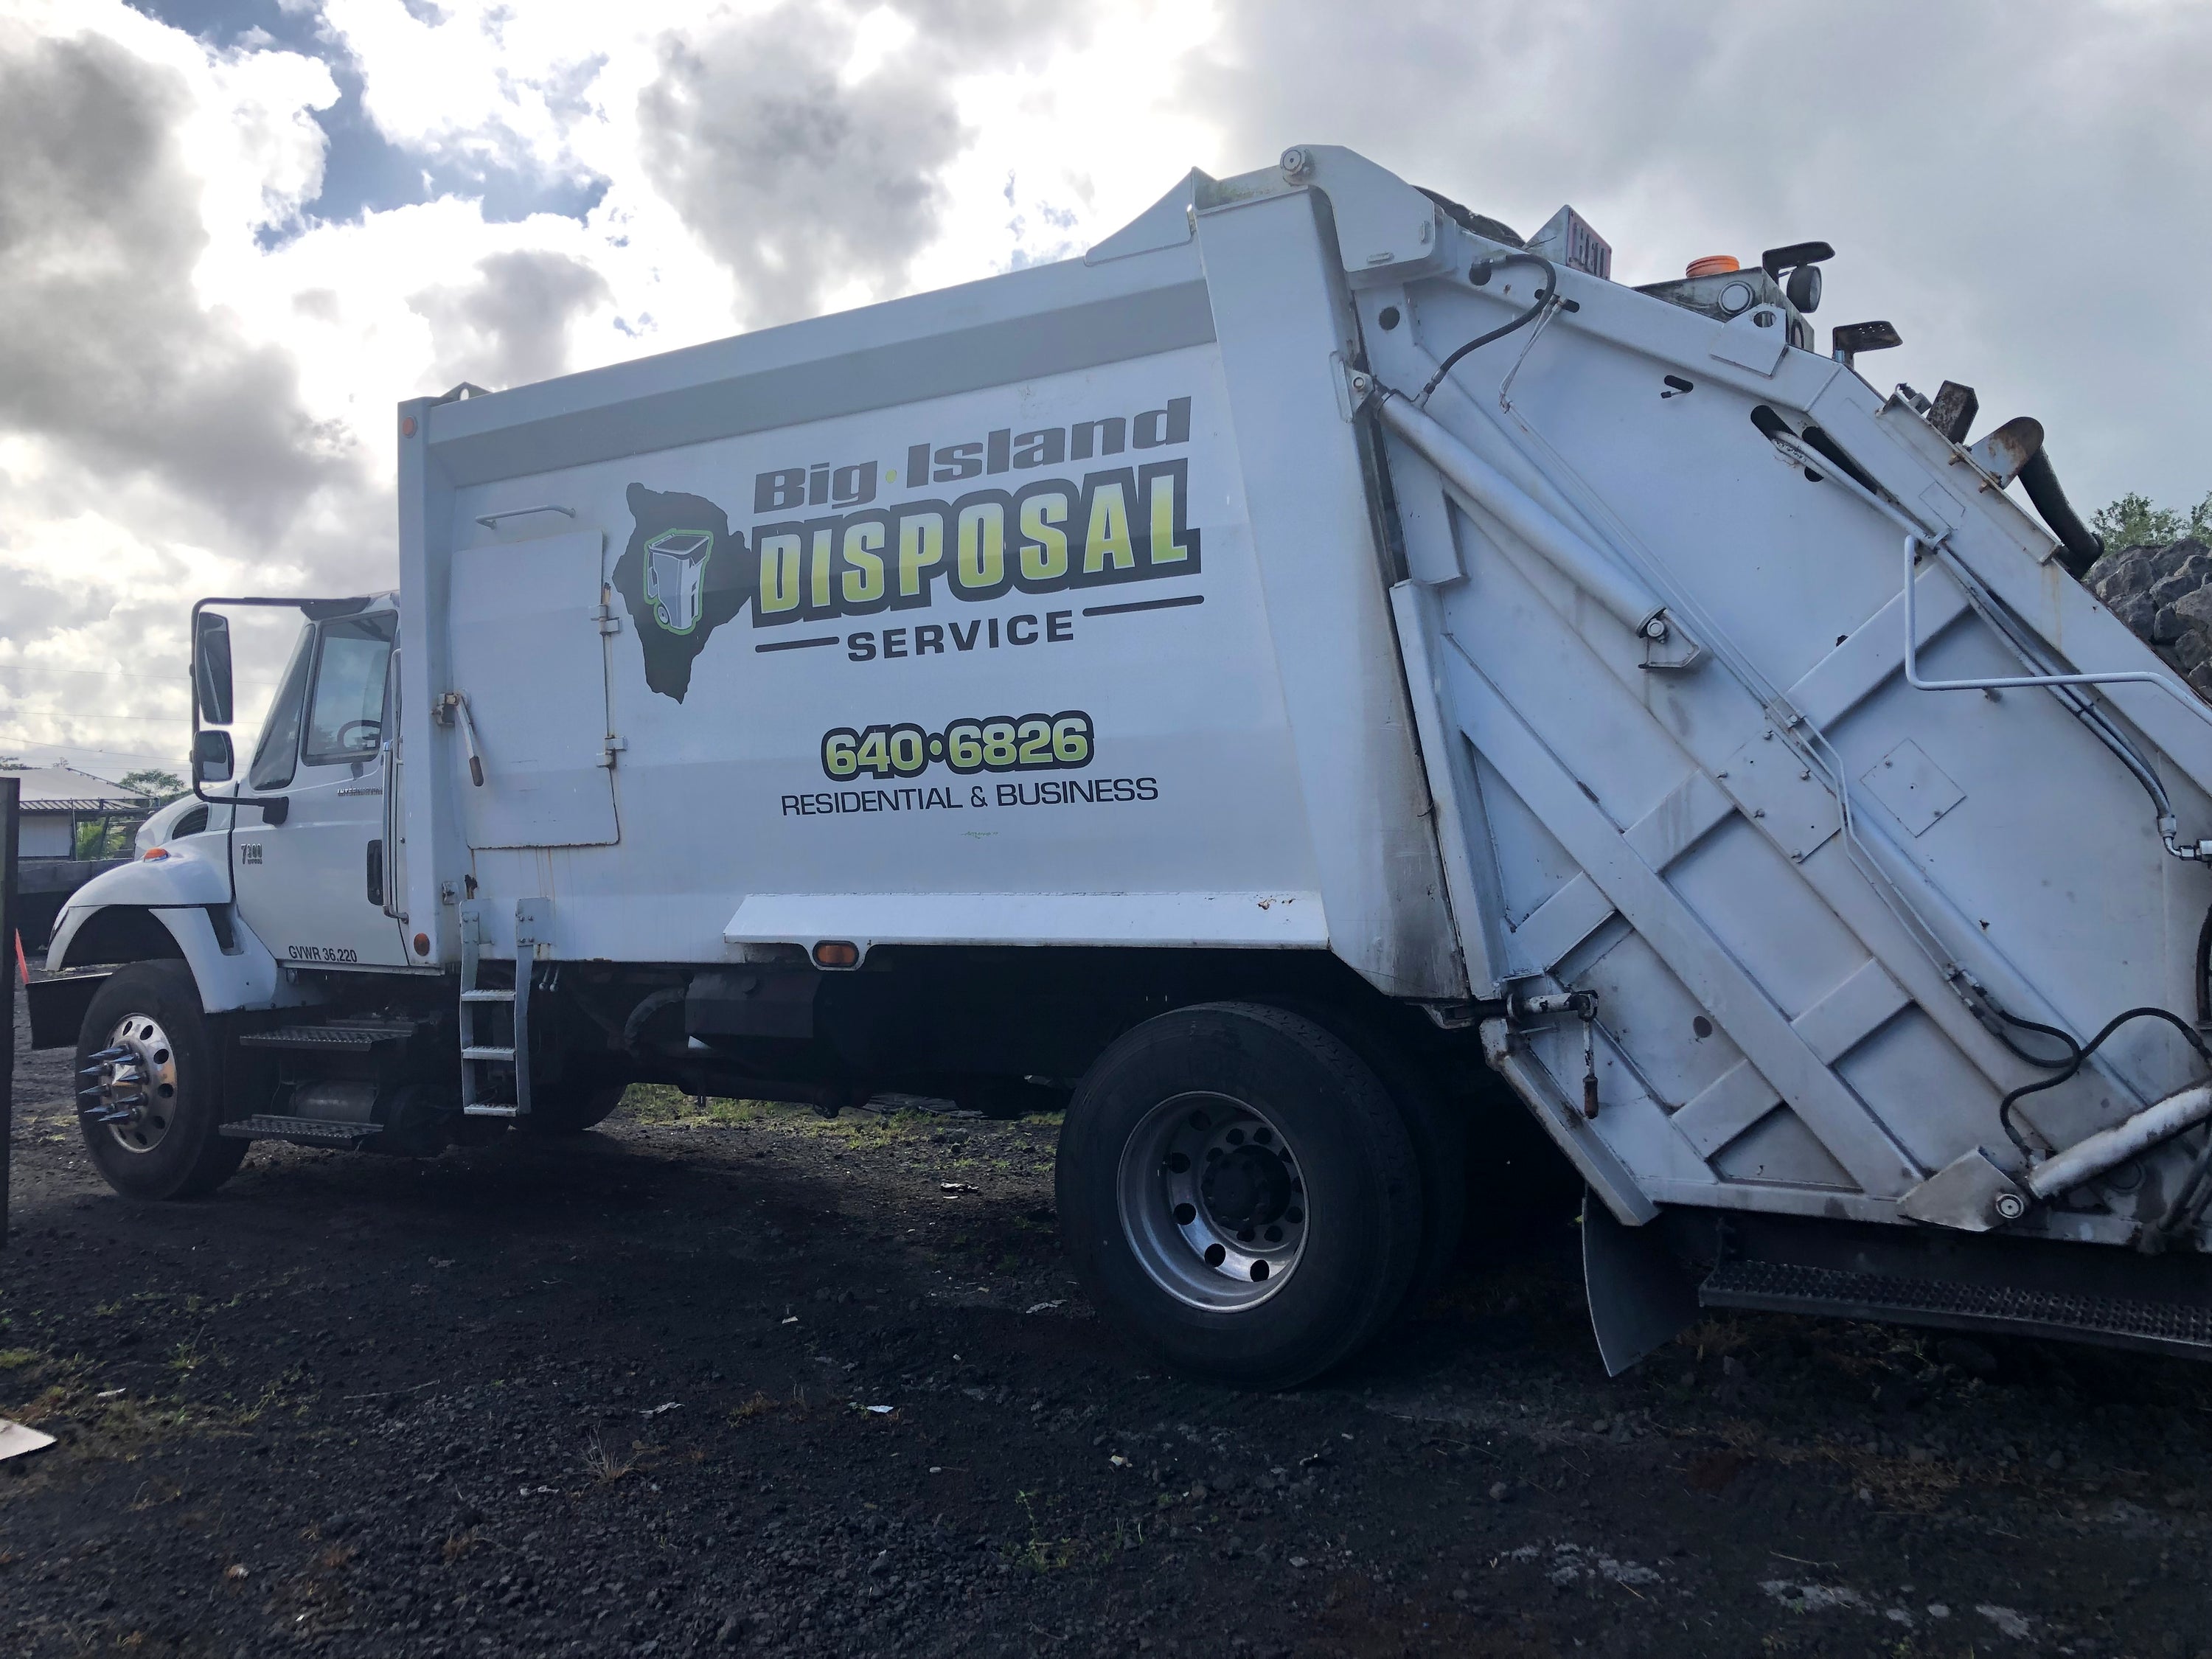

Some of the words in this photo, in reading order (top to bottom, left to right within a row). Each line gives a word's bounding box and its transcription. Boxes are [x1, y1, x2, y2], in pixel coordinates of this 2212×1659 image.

[754, 460, 877, 514] Big
[906, 396, 1191, 488] Island
[754, 463, 1197, 623] DISPOSAL
[848, 610, 1074, 662] SERVICE
[782, 786, 963, 816] RESIDENTIAL
[970, 785, 989, 807] &
[996, 777, 1158, 807] BUSINESS
[288, 945, 321, 960] GVWR
